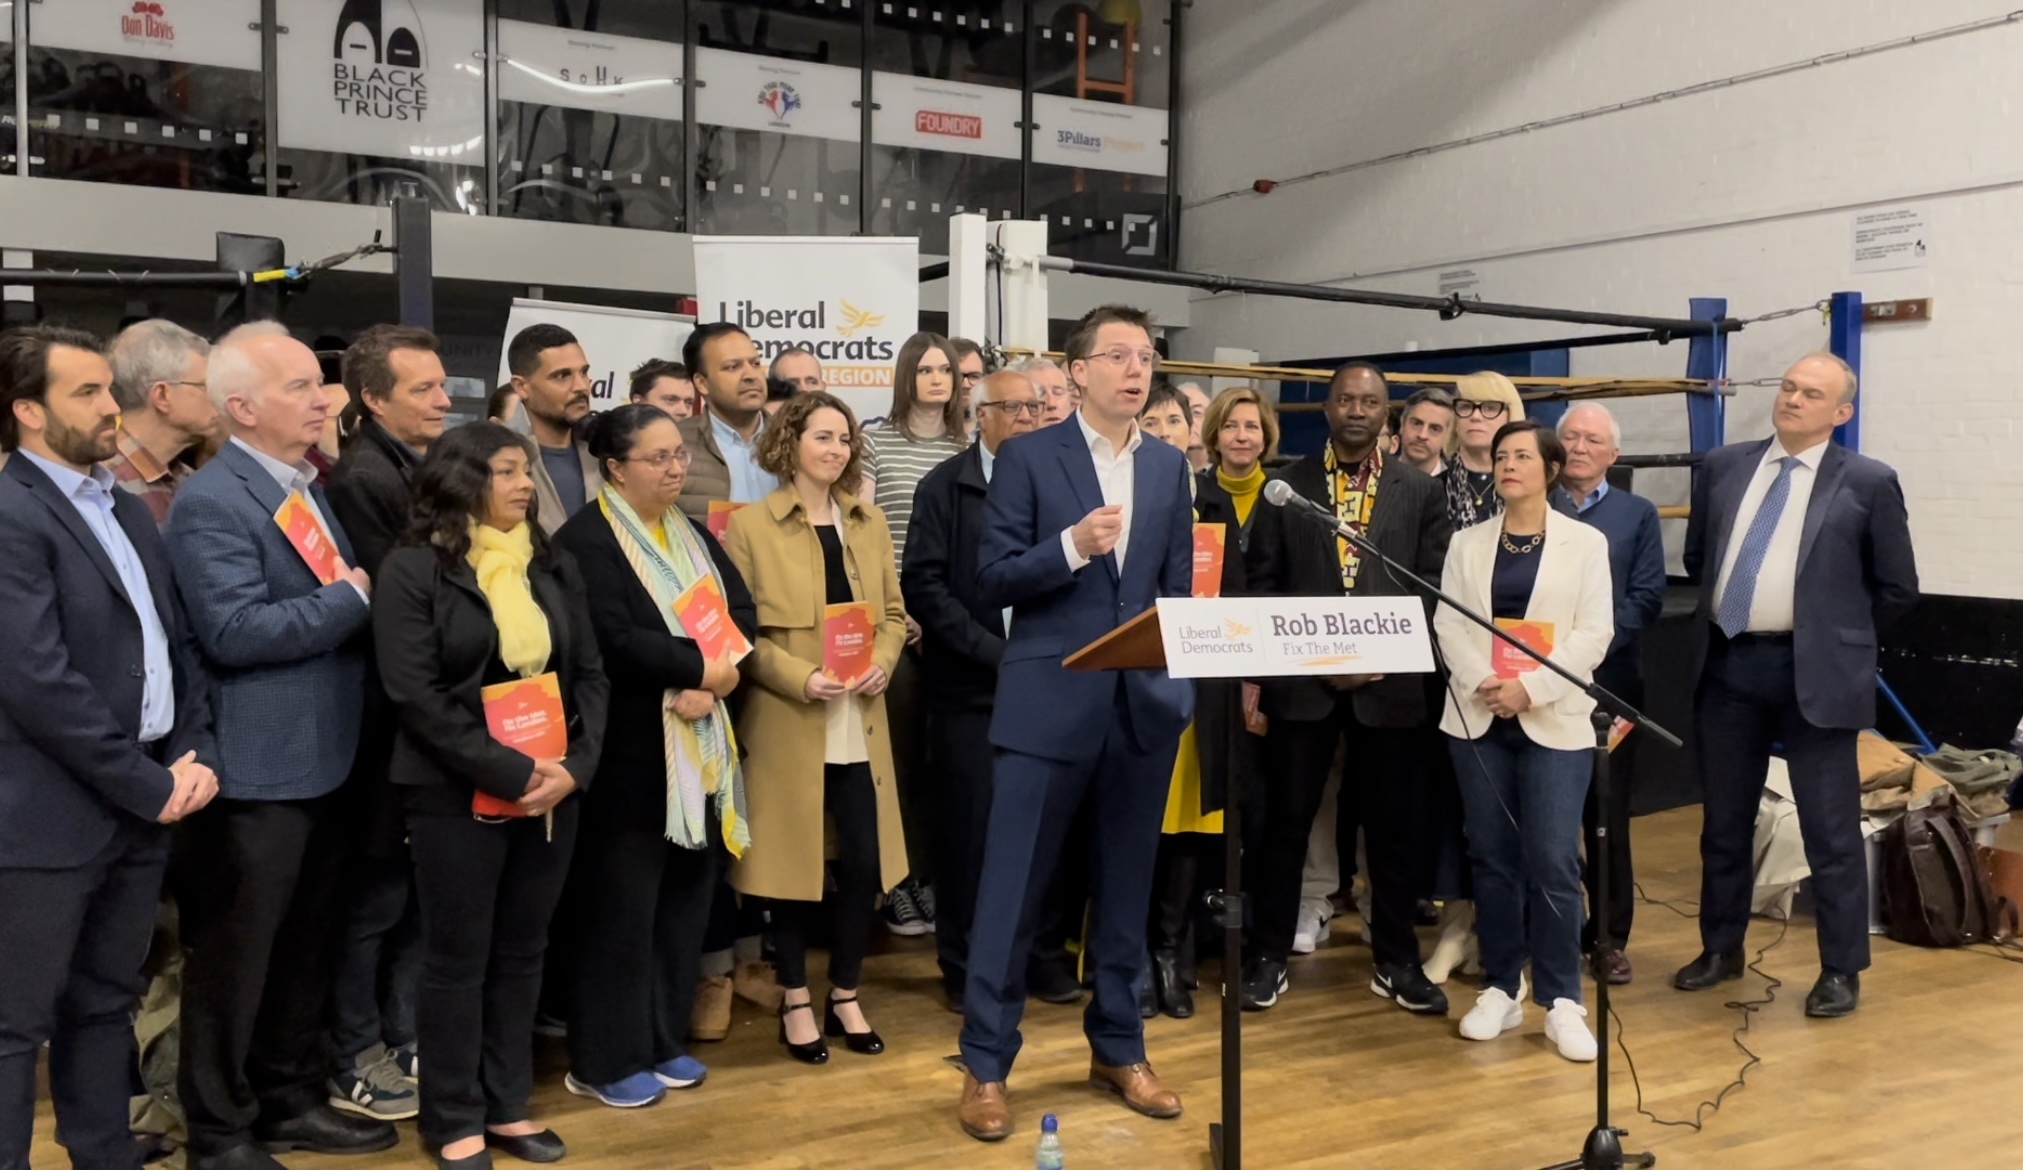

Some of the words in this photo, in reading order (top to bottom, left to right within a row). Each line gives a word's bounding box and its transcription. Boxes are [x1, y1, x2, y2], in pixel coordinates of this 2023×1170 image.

[145, 14, 174, 40] Davis
[333, 63, 427, 90] BLACK
[334, 80, 428, 106] PRINCE
[334, 97, 428, 122] TRUST
[917, 113, 980, 137] FOUNDRY
[1057, 130, 1102, 148] 3Pillars
[719, 300, 825, 329] Liberal
[751, 336, 893, 360] emocrats
[822, 367, 892, 385] REGION
[1179, 625, 1222, 640] Liberal
[1271, 612, 1318, 637] Rob
[1323, 611, 1413, 636] Blackie
[1181, 640, 1254, 655] Democrats
[1282, 641, 1304, 656] Fix
[1305, 641, 1330, 655] The
[1333, 641, 1358, 655] Met
